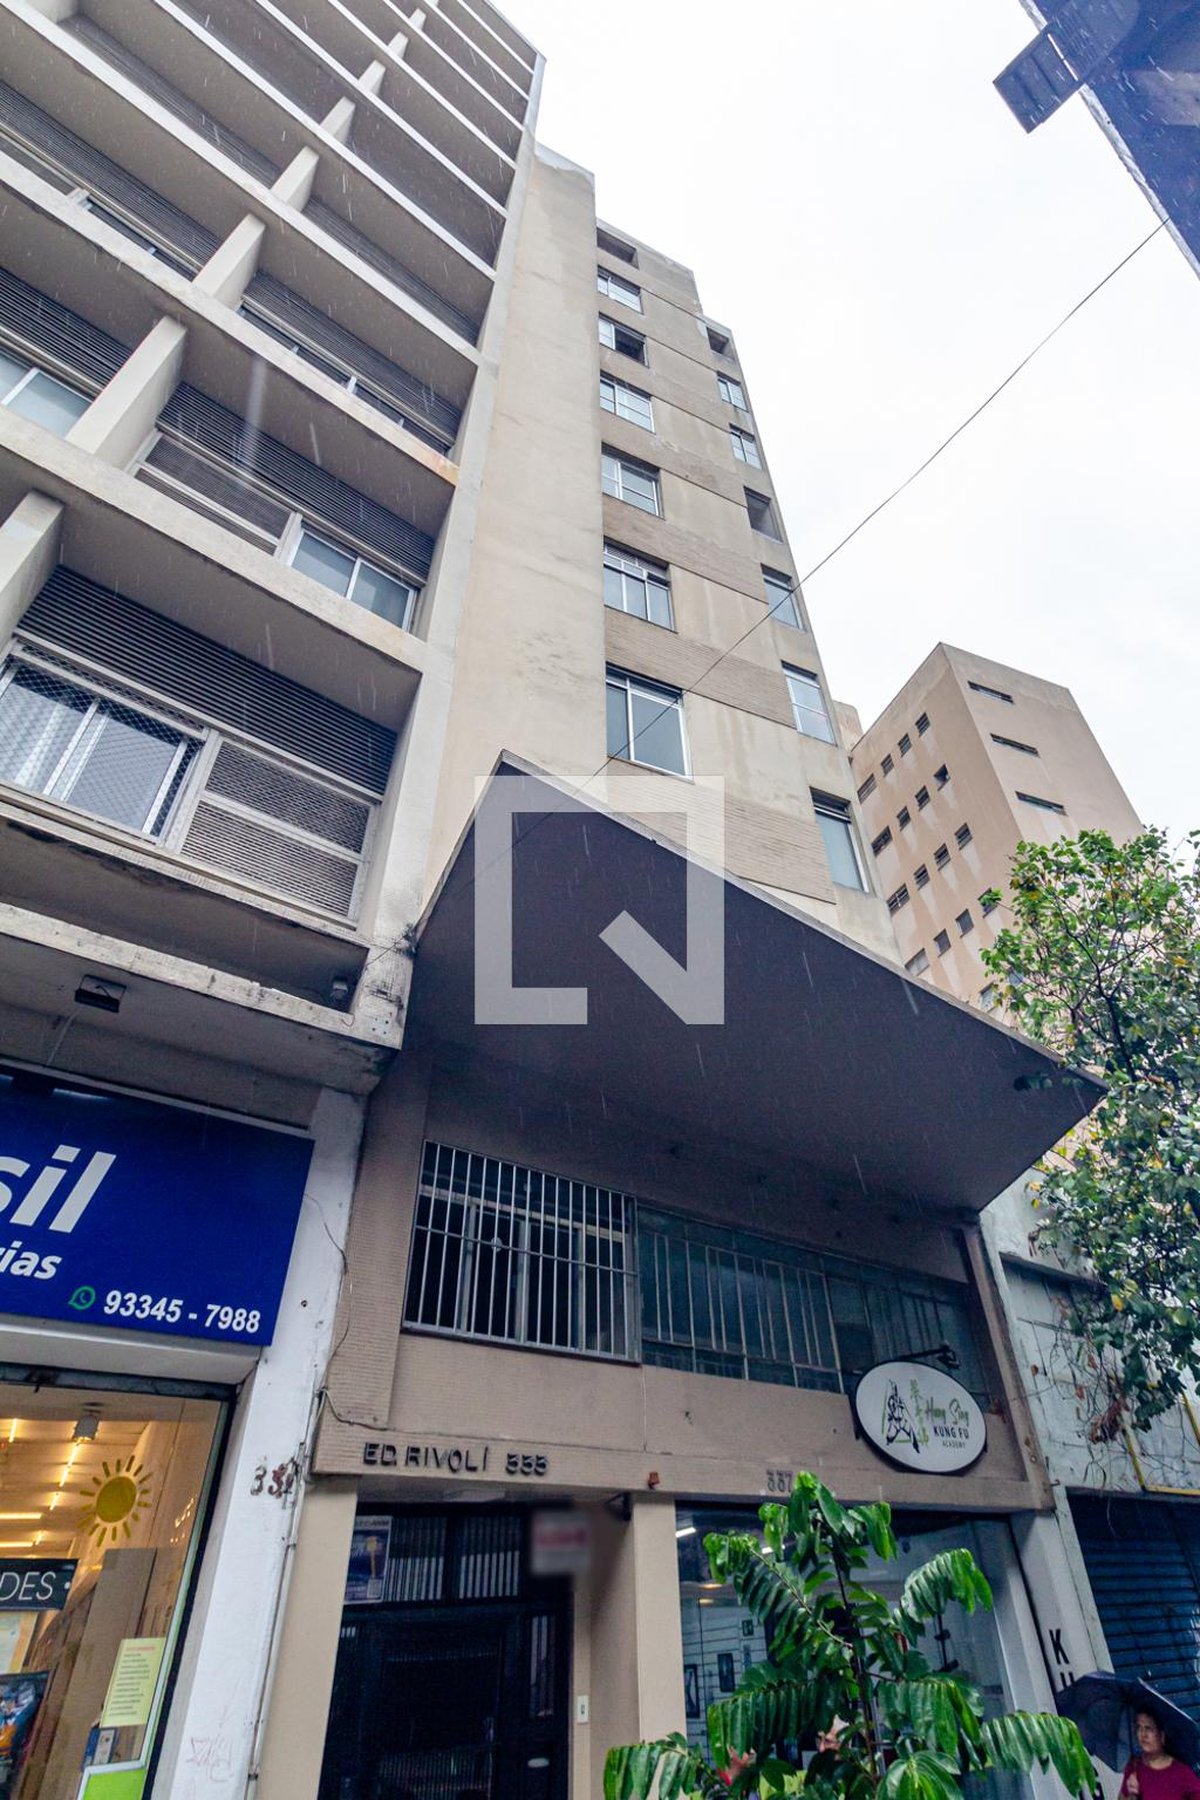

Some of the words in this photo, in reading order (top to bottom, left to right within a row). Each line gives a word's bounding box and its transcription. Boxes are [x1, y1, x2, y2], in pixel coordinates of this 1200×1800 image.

[0, 1240, 63, 1280] ias
[103, 1290, 183, 1323] 93345
[205, 1303, 261, 1334] 7988
[933, 1425, 957, 1438] KUNG
[958, 1427, 970, 1439] FU
[405, 1445, 489, 1473] RIVOLI
